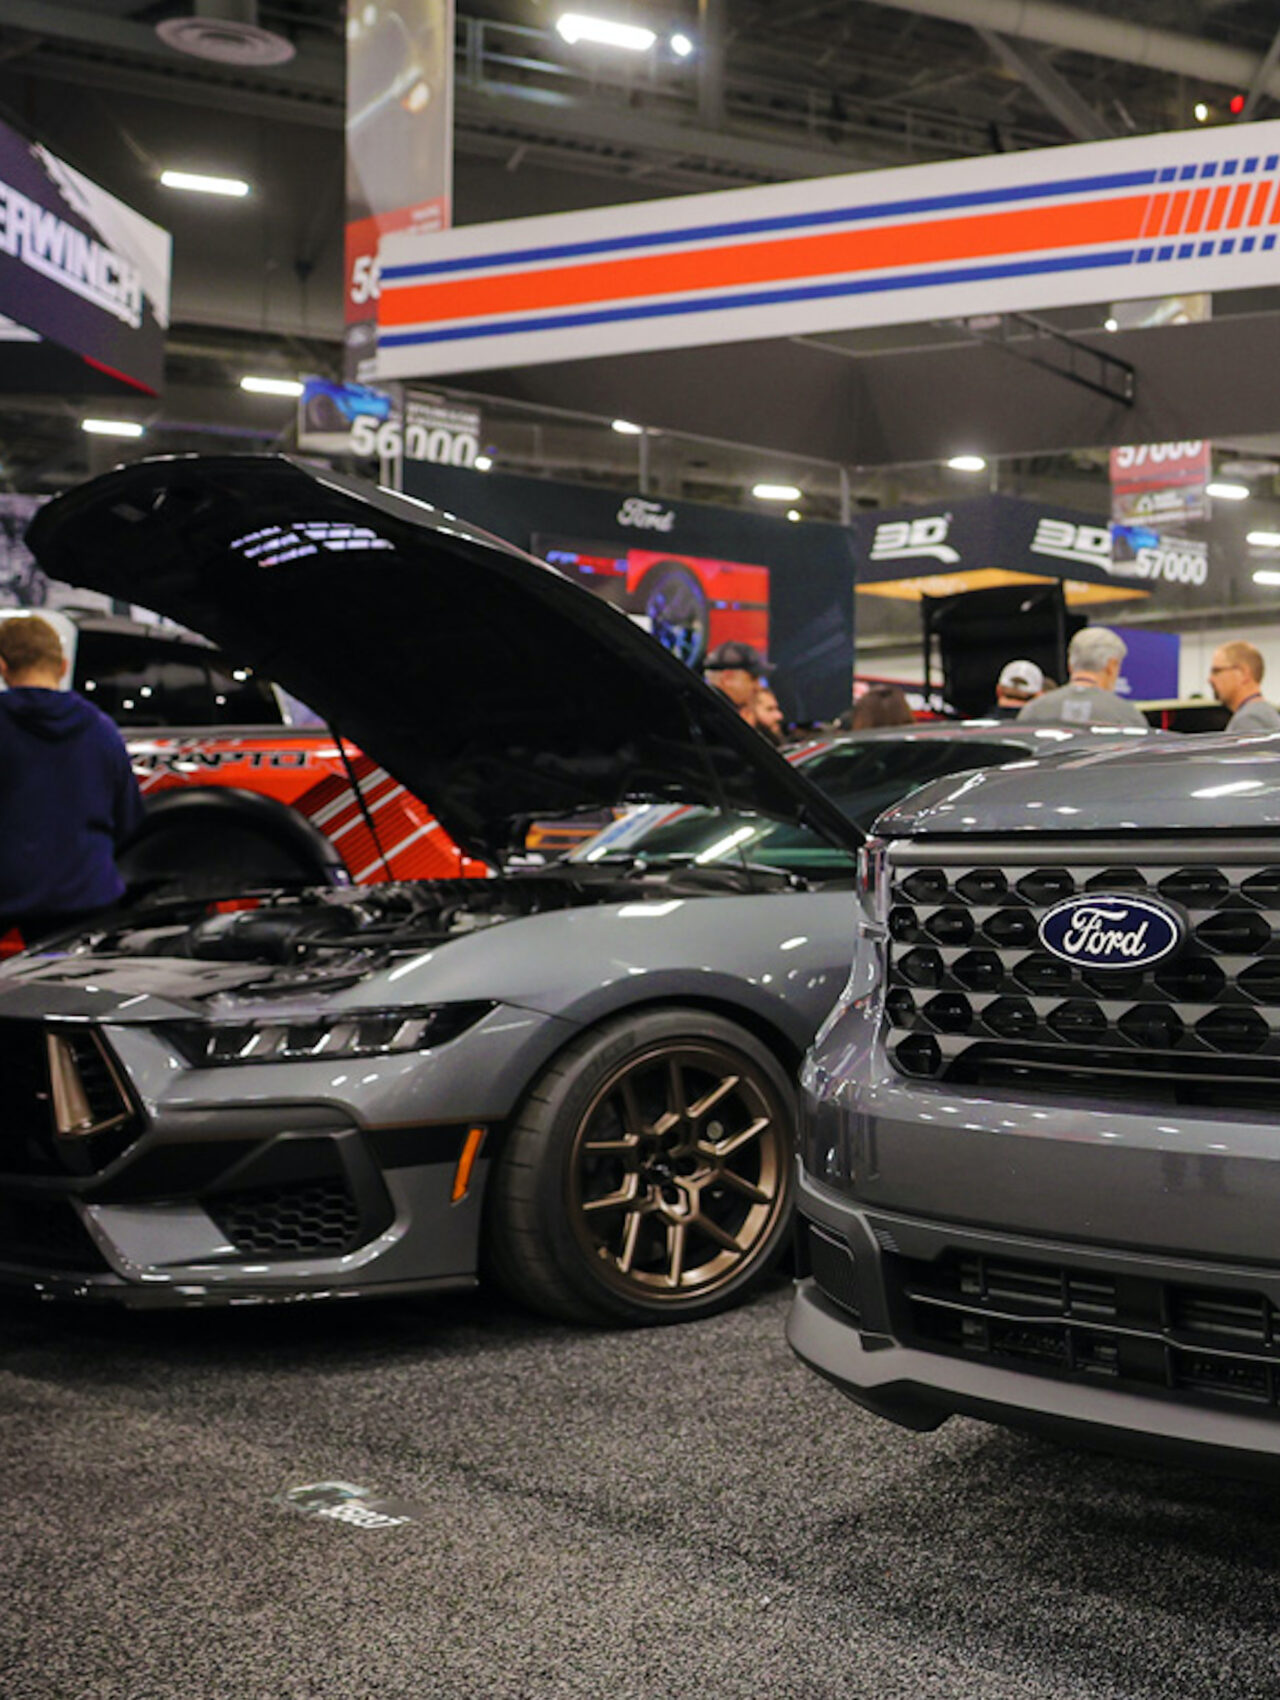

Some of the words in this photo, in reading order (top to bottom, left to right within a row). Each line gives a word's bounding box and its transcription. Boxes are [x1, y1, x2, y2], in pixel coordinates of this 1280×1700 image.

[350, 414, 479, 468] 56000
[617, 498, 675, 532] Ford
[1136, 548, 1208, 585] 57000
[1062, 907, 1149, 957] Ford
